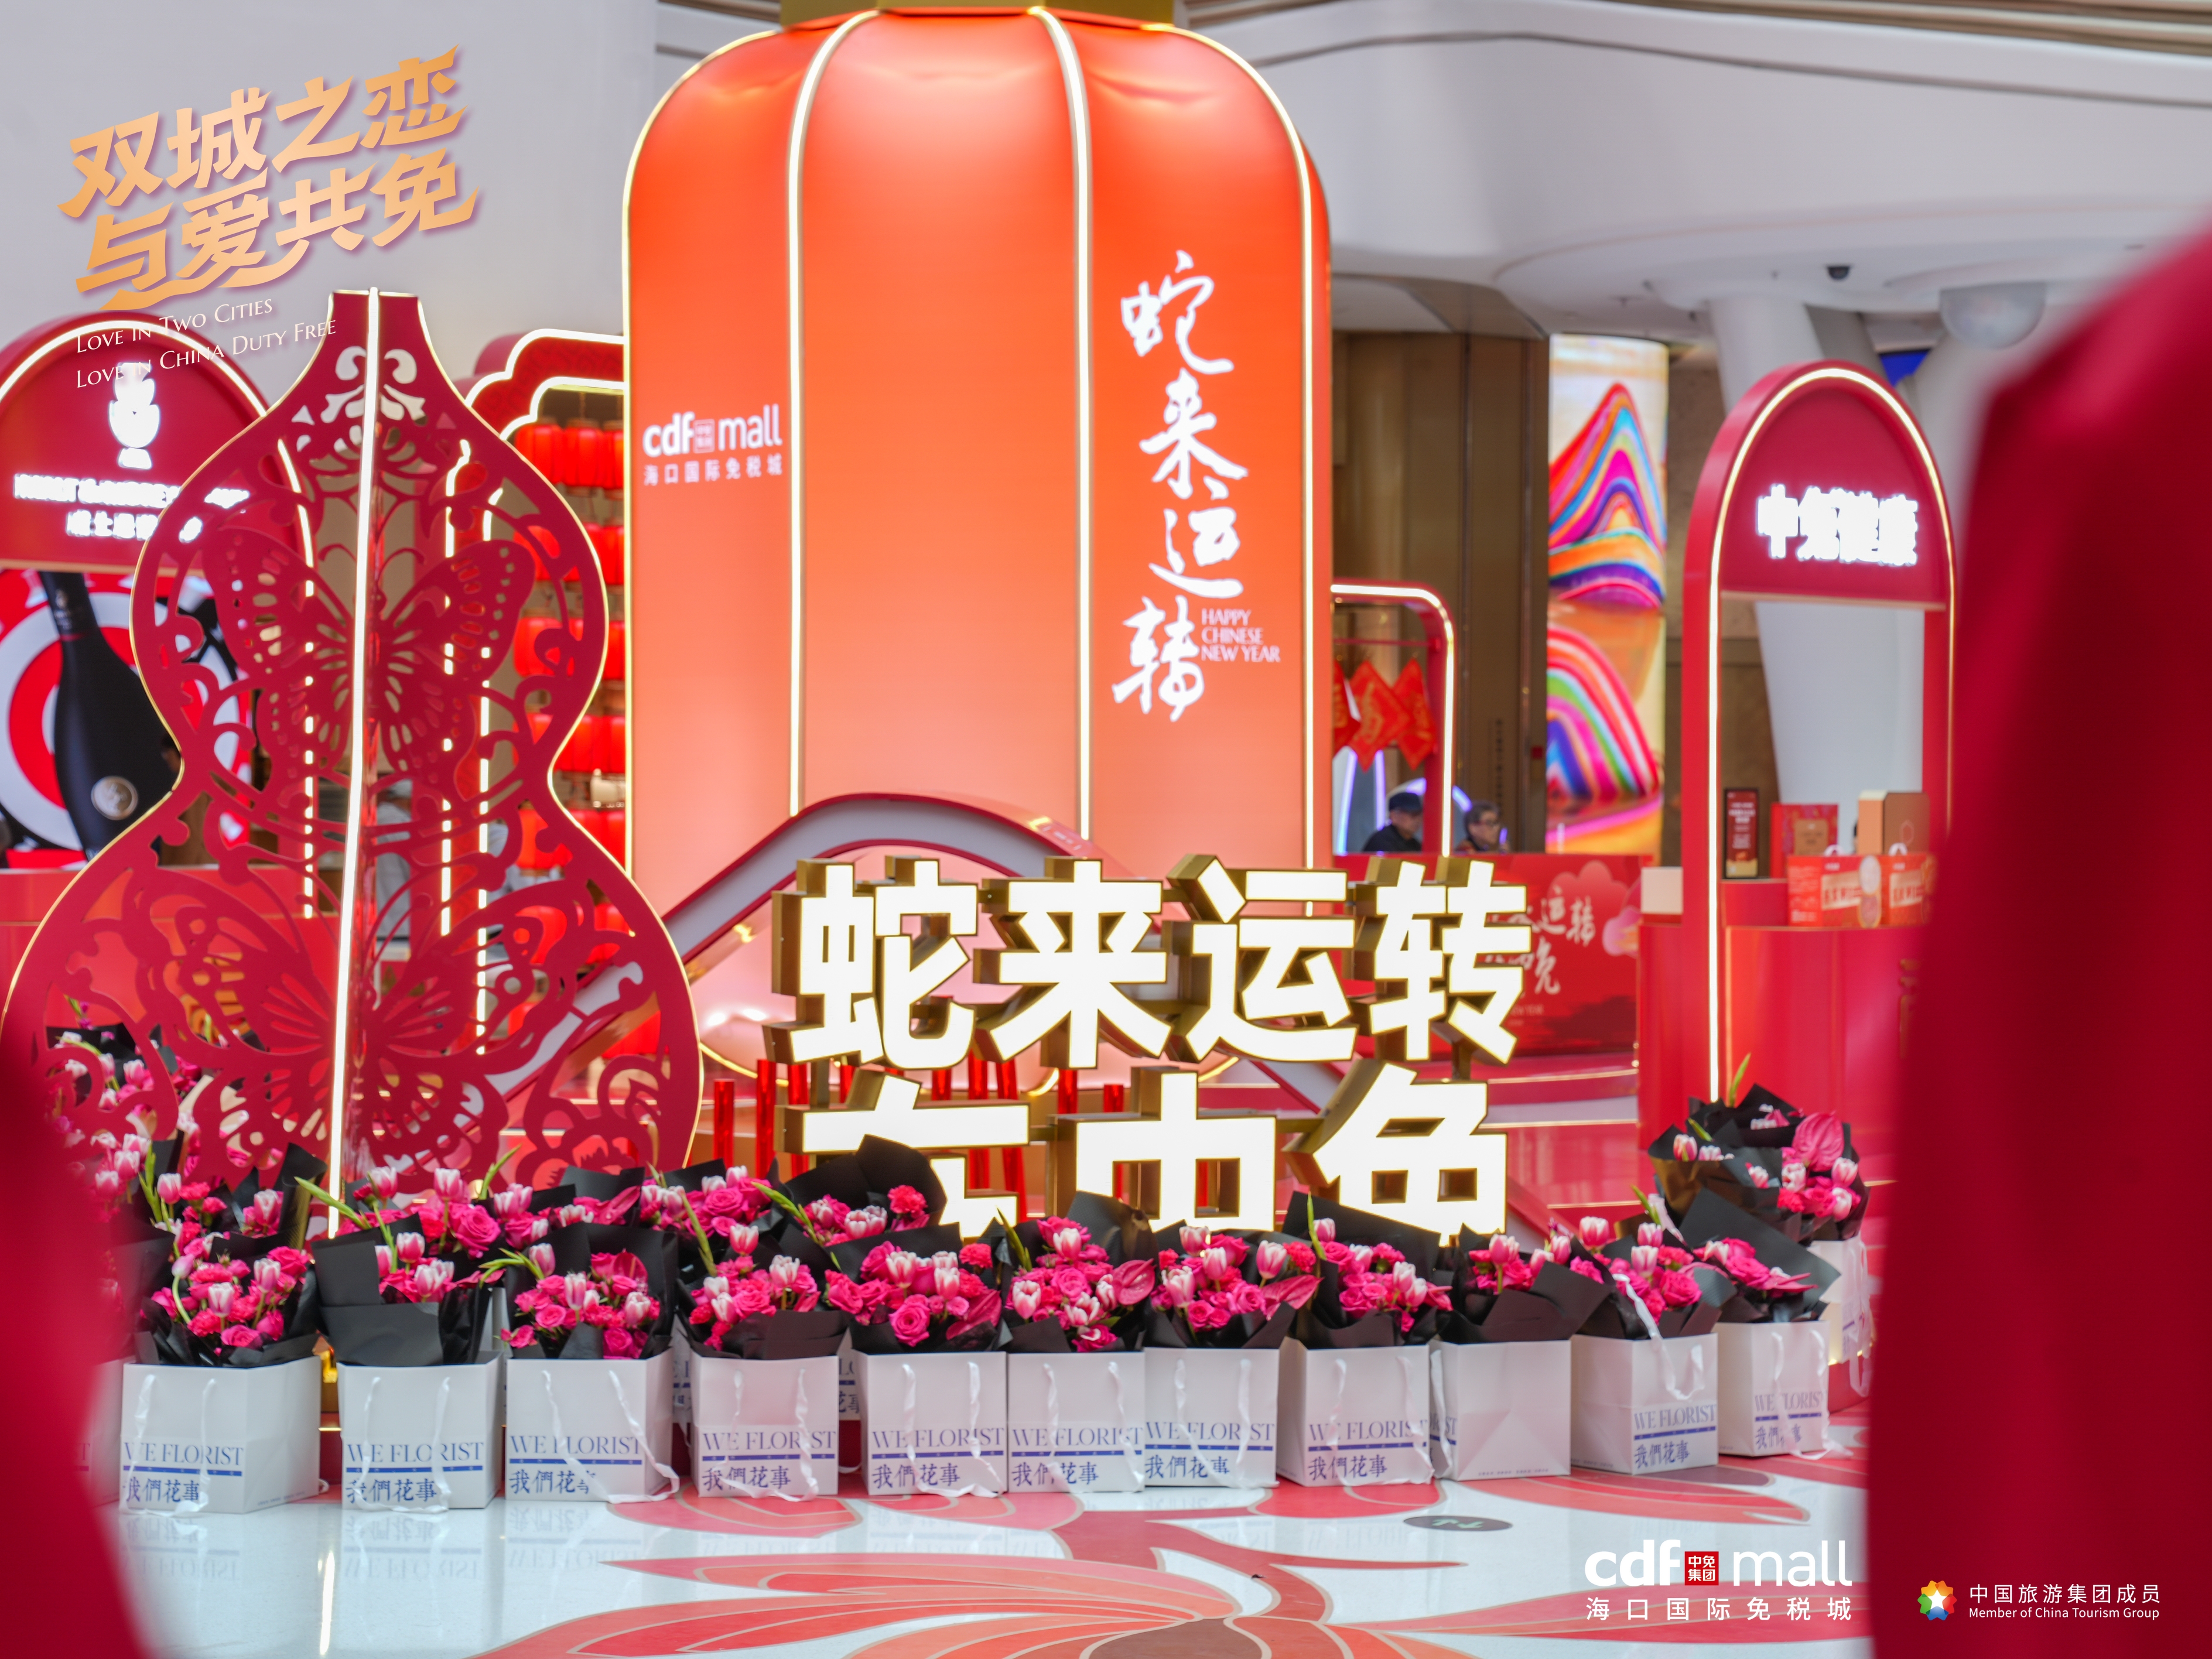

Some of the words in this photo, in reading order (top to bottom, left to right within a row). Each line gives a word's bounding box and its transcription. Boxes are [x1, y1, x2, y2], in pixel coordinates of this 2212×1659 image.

[643, 412, 695, 457] cdf
[718, 404, 782, 451] mall
[644, 453, 782, 486] 海口国际免税城
[1201, 608, 1252, 626] HAPPY
[1201, 626, 1264, 645] CHINESE
[1201, 645, 1239, 662] NEW
[1240, 645, 1281, 663] YEAR
[790, 857, 1533, 1069] 蛇来运转
[1782, 1391, 1823, 1410] LORIS
[1634, 1411, 1656, 1430] WE
[1660, 1404, 1717, 1427] FLORIST
[703, 1433, 739, 1451] WE
[746, 1431, 836, 1451] FLORST
[873, 1431, 907, 1448] WE
[1013, 1429, 1048, 1446] WE
[1146, 1422, 1179, 1440] WE
[1188, 1422, 1275, 1441] FLORST
[163, 1443, 244, 1465] FLORIST
[391, 1442, 484, 1462] FLORIST
[511, 1436, 546, 1453] WE
[1634, 1439, 1690, 1469] 我們花事
[872, 1463, 960, 1489] 我們花事
